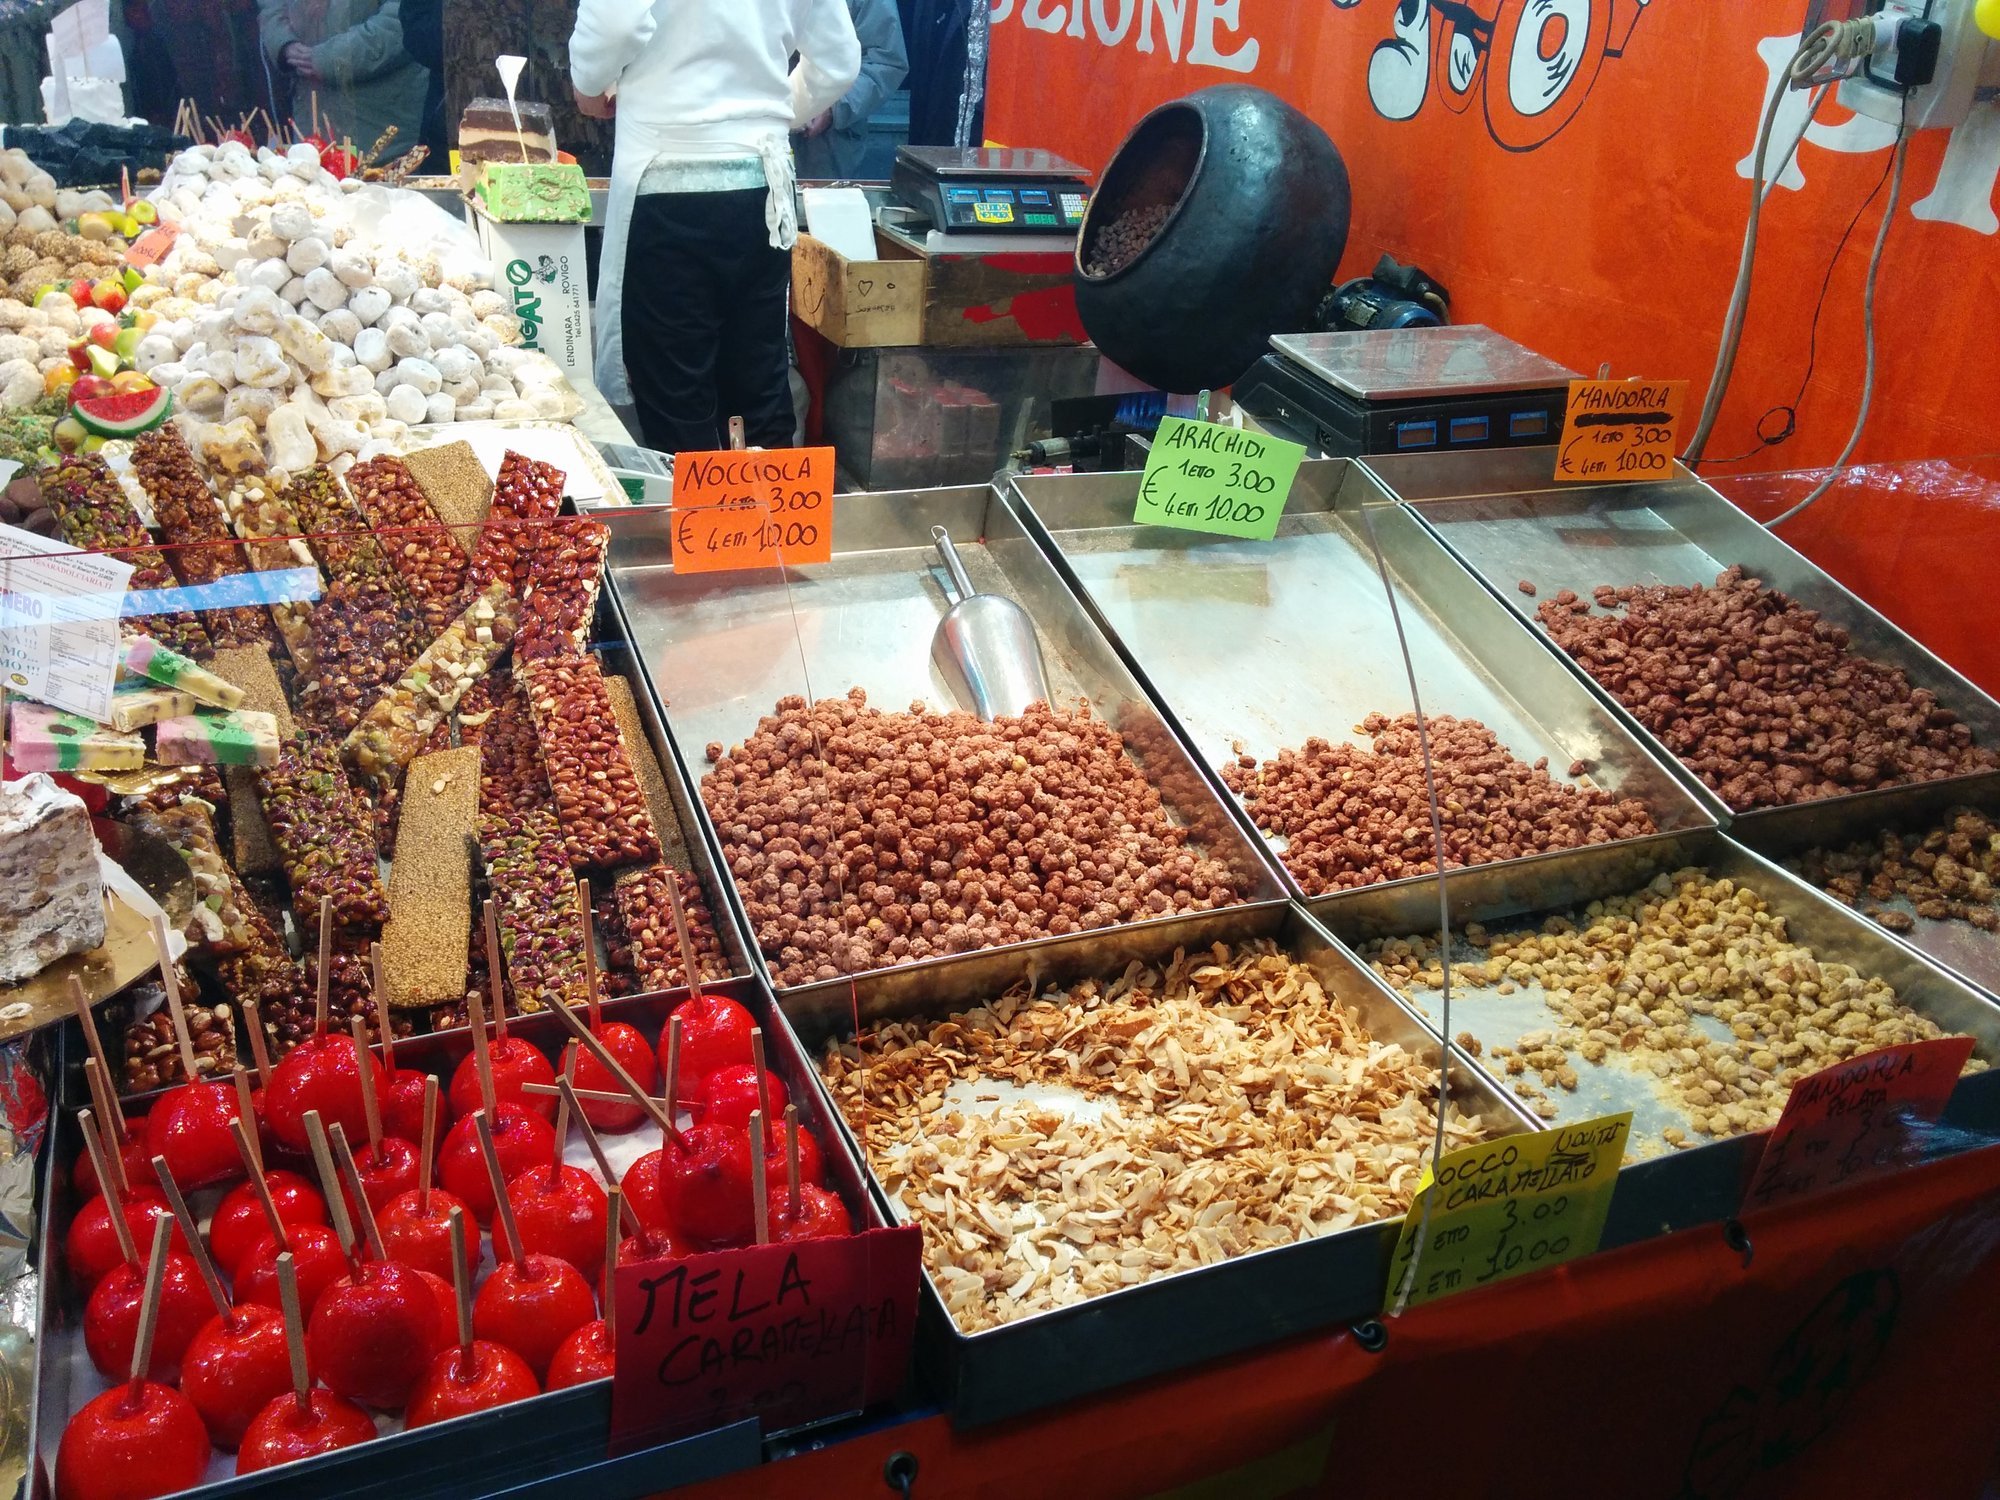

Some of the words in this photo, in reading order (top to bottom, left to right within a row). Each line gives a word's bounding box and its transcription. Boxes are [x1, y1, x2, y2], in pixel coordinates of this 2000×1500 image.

[560, 255, 570, 294] ROVIGO
[506, 259, 545, 354] IGATO
[565, 316, 575, 367] LENDINARA
[1571, 386, 1670, 409] MANDORLA
[1165, 423, 1266, 458] ARACHIDI
[1225, 463, 1275, 493] 3.00
[1616, 448, 1666, 472] 10.00
[769, 486, 822, 513] 3.00
[1205, 494, 1264, 522] 10.00
[752, 519, 818, 552] 10.00
[1435, 1145, 1518, 1187] OCCO
[1447, 1163, 1597, 1210] CARAMELLATO
[1499, 1196, 1568, 1233] 3.00
[1477, 1232, 1570, 1282] 10.00
[634, 1252, 812, 1335] MELA
